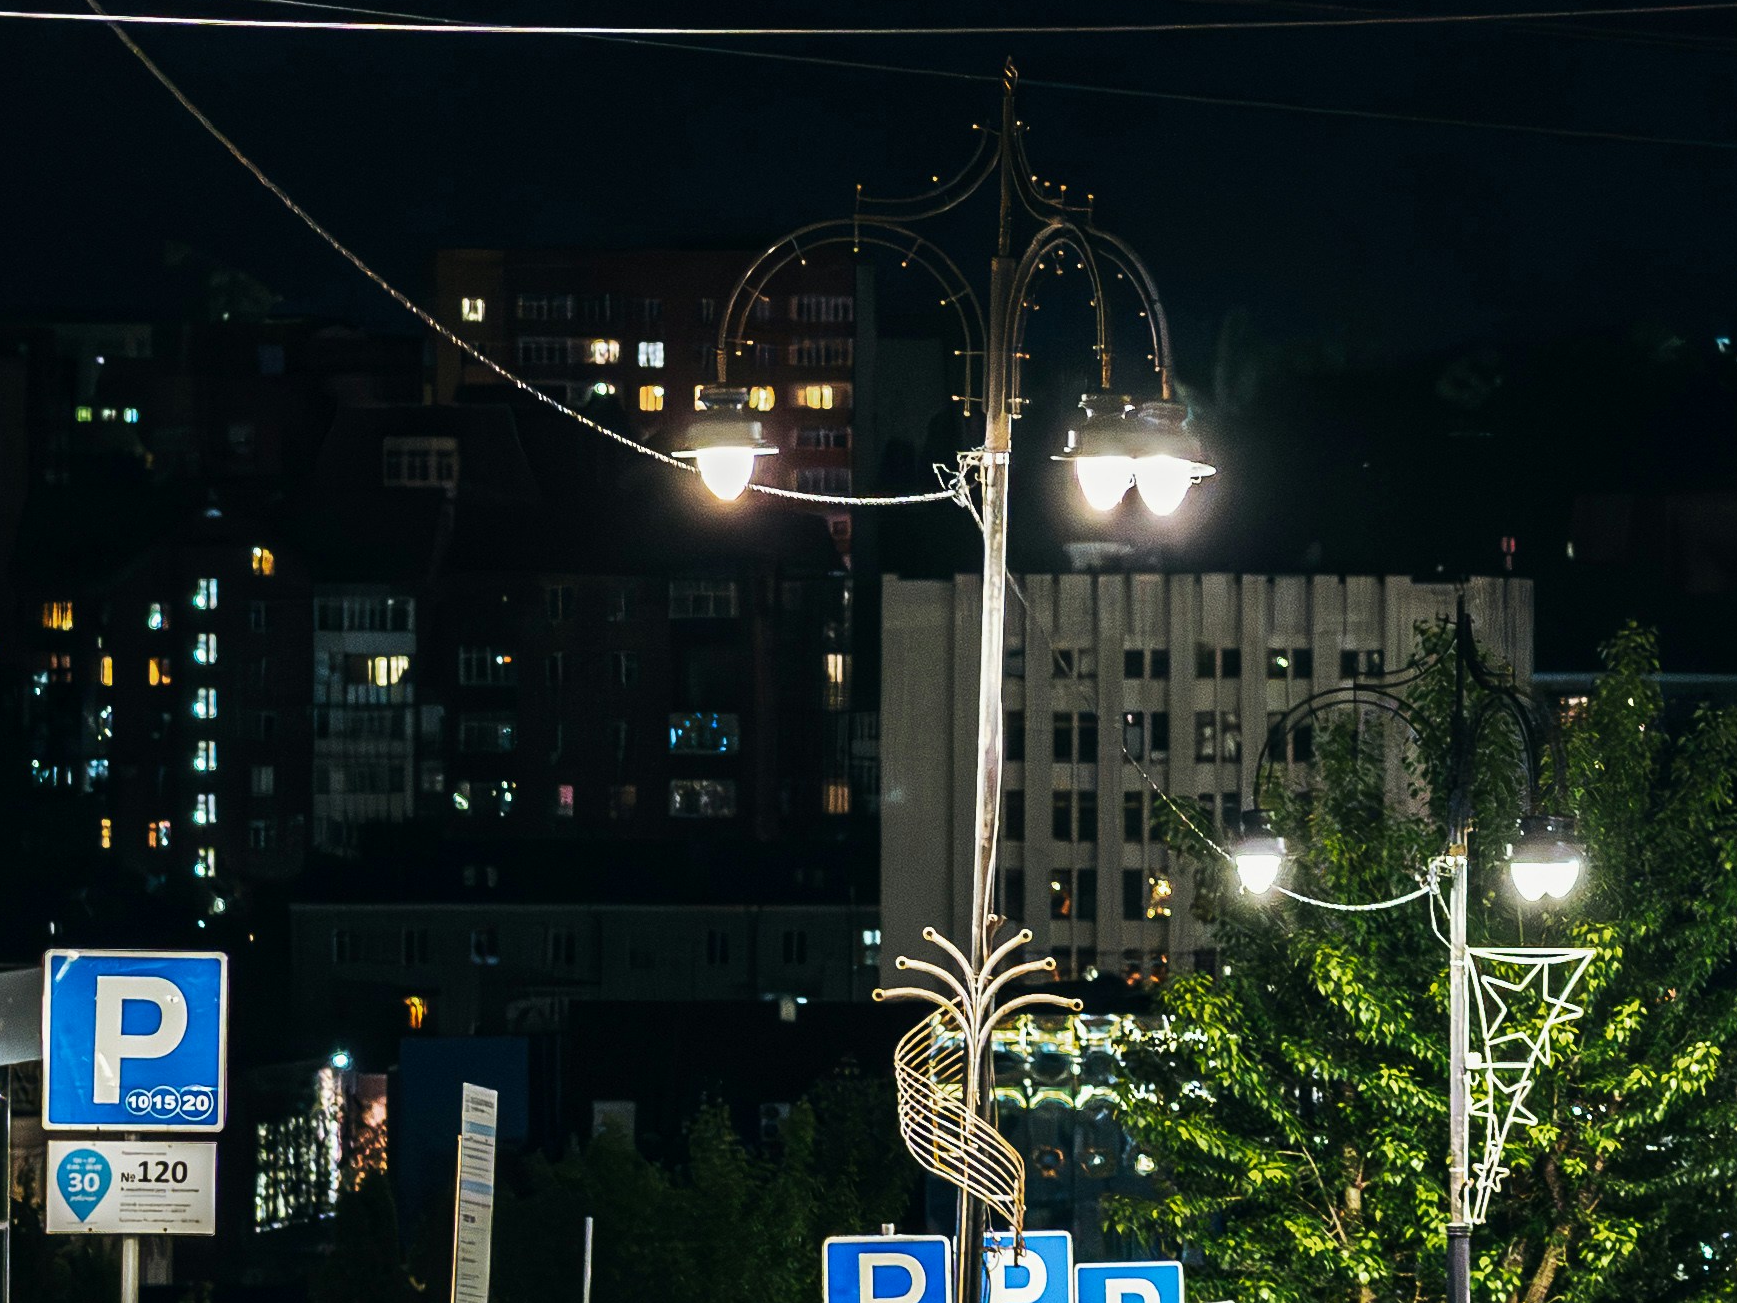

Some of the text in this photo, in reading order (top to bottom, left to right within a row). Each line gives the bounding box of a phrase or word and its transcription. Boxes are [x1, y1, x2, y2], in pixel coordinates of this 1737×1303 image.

[93, 975, 188, 1105] P
[128, 1095, 209, 1112] 10 15 20
[67, 1172, 101, 1193] 30
